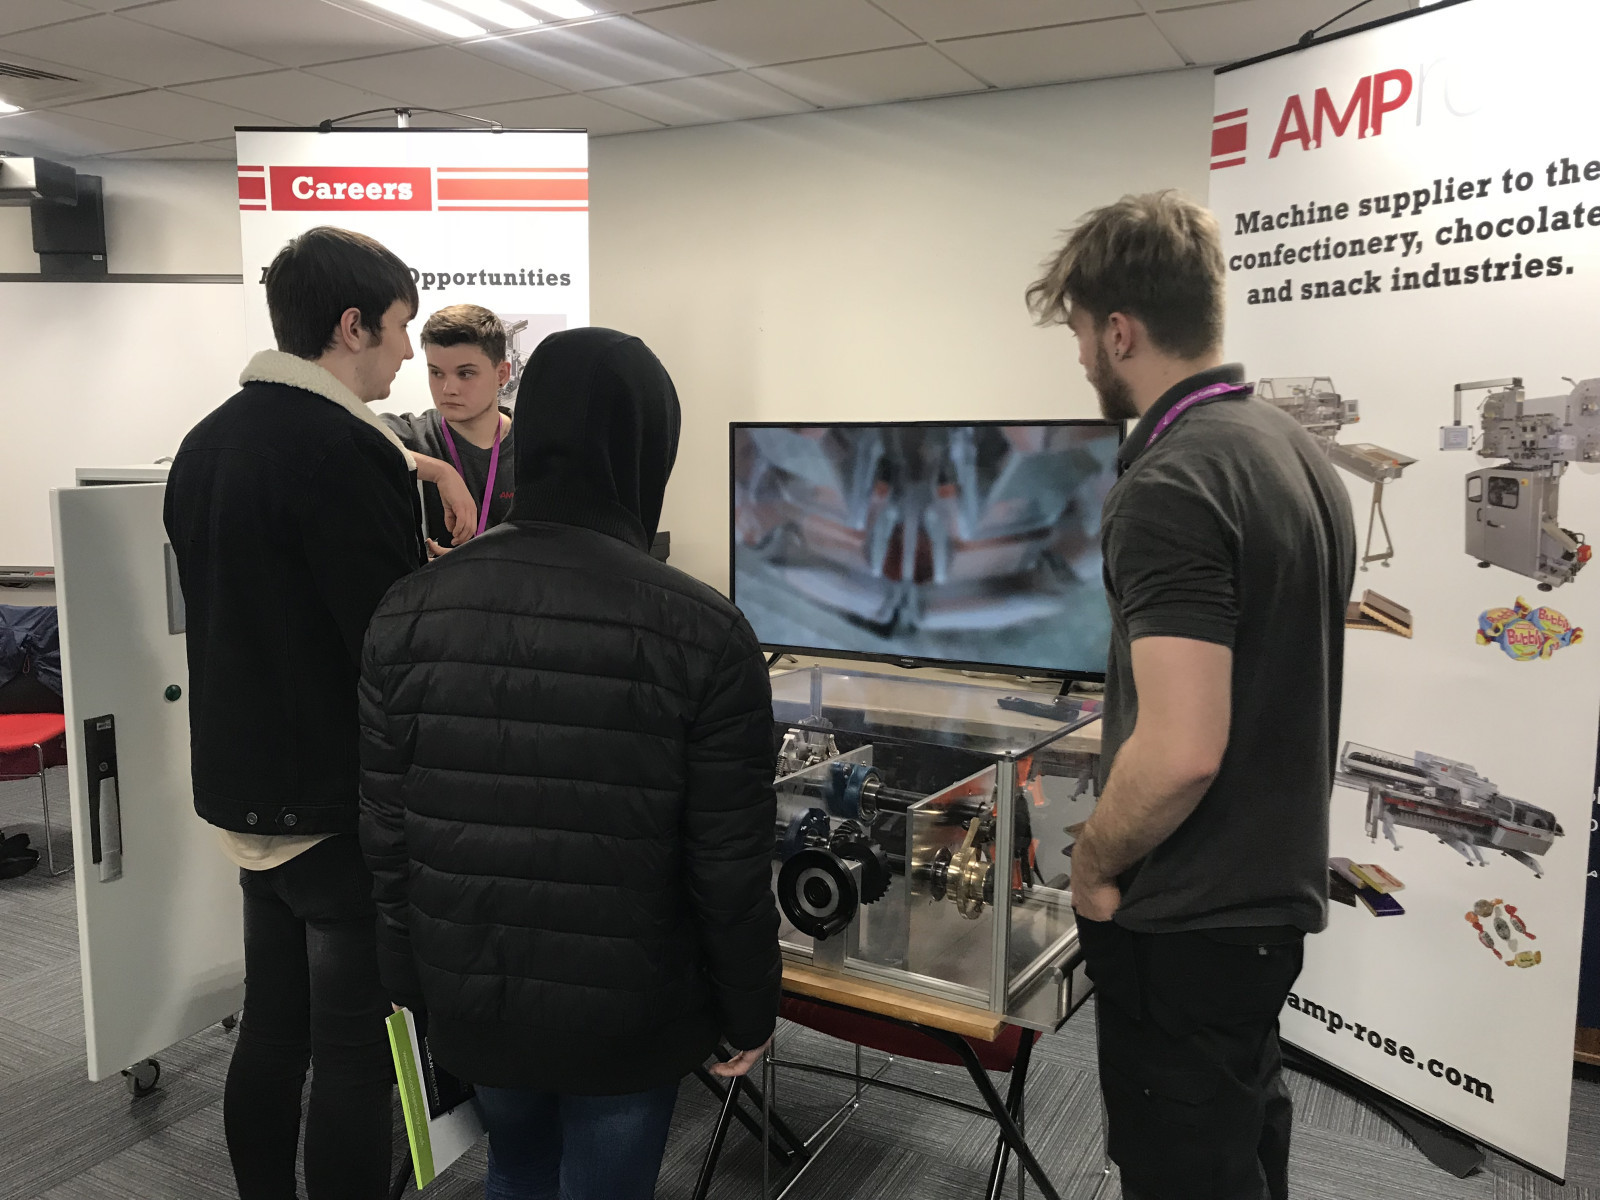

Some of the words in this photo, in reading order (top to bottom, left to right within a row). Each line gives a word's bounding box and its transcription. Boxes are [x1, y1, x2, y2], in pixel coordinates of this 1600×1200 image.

[291, 176, 413, 200] Careers
[1234, 202, 1349, 236] Machine
[1359, 177, 1492, 219] supplier
[1502, 171, 1533, 193] to
[1546, 158, 1600, 187] the
[1229, 232, 1423, 272] confectionery,
[1435, 204, 1600, 245] chocolate
[1247, 279, 1293, 305] and
[1301, 271, 1382, 300] snack
[1391, 253, 1574, 292] industries.
[1506, 628, 1543, 650] Bubbly
